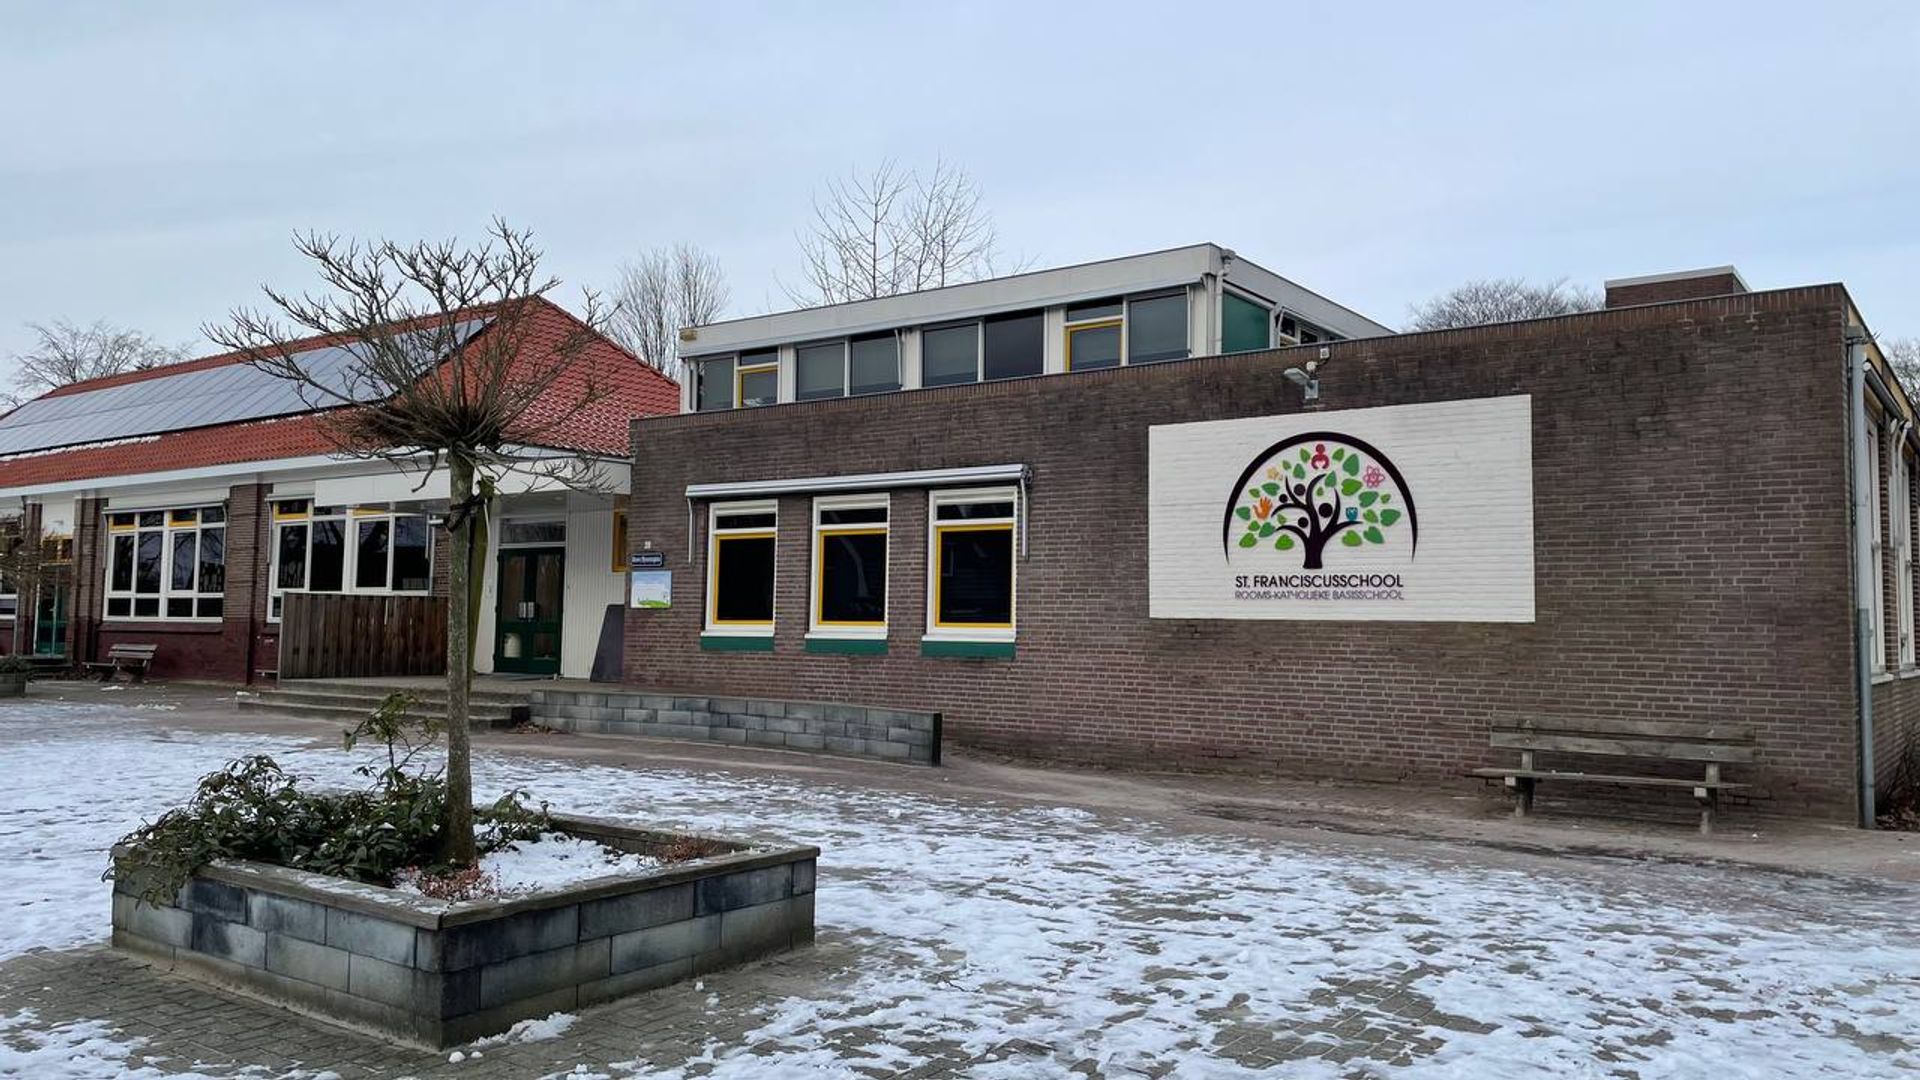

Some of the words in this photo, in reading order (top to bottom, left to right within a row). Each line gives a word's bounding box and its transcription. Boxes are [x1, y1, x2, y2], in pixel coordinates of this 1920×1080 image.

[1235, 575, 1250, 588] ST.
[1254, 574, 1404, 588] FRANCISCUSSCHOOL
[1332, 590, 1404, 601] BASISSCHOOL
